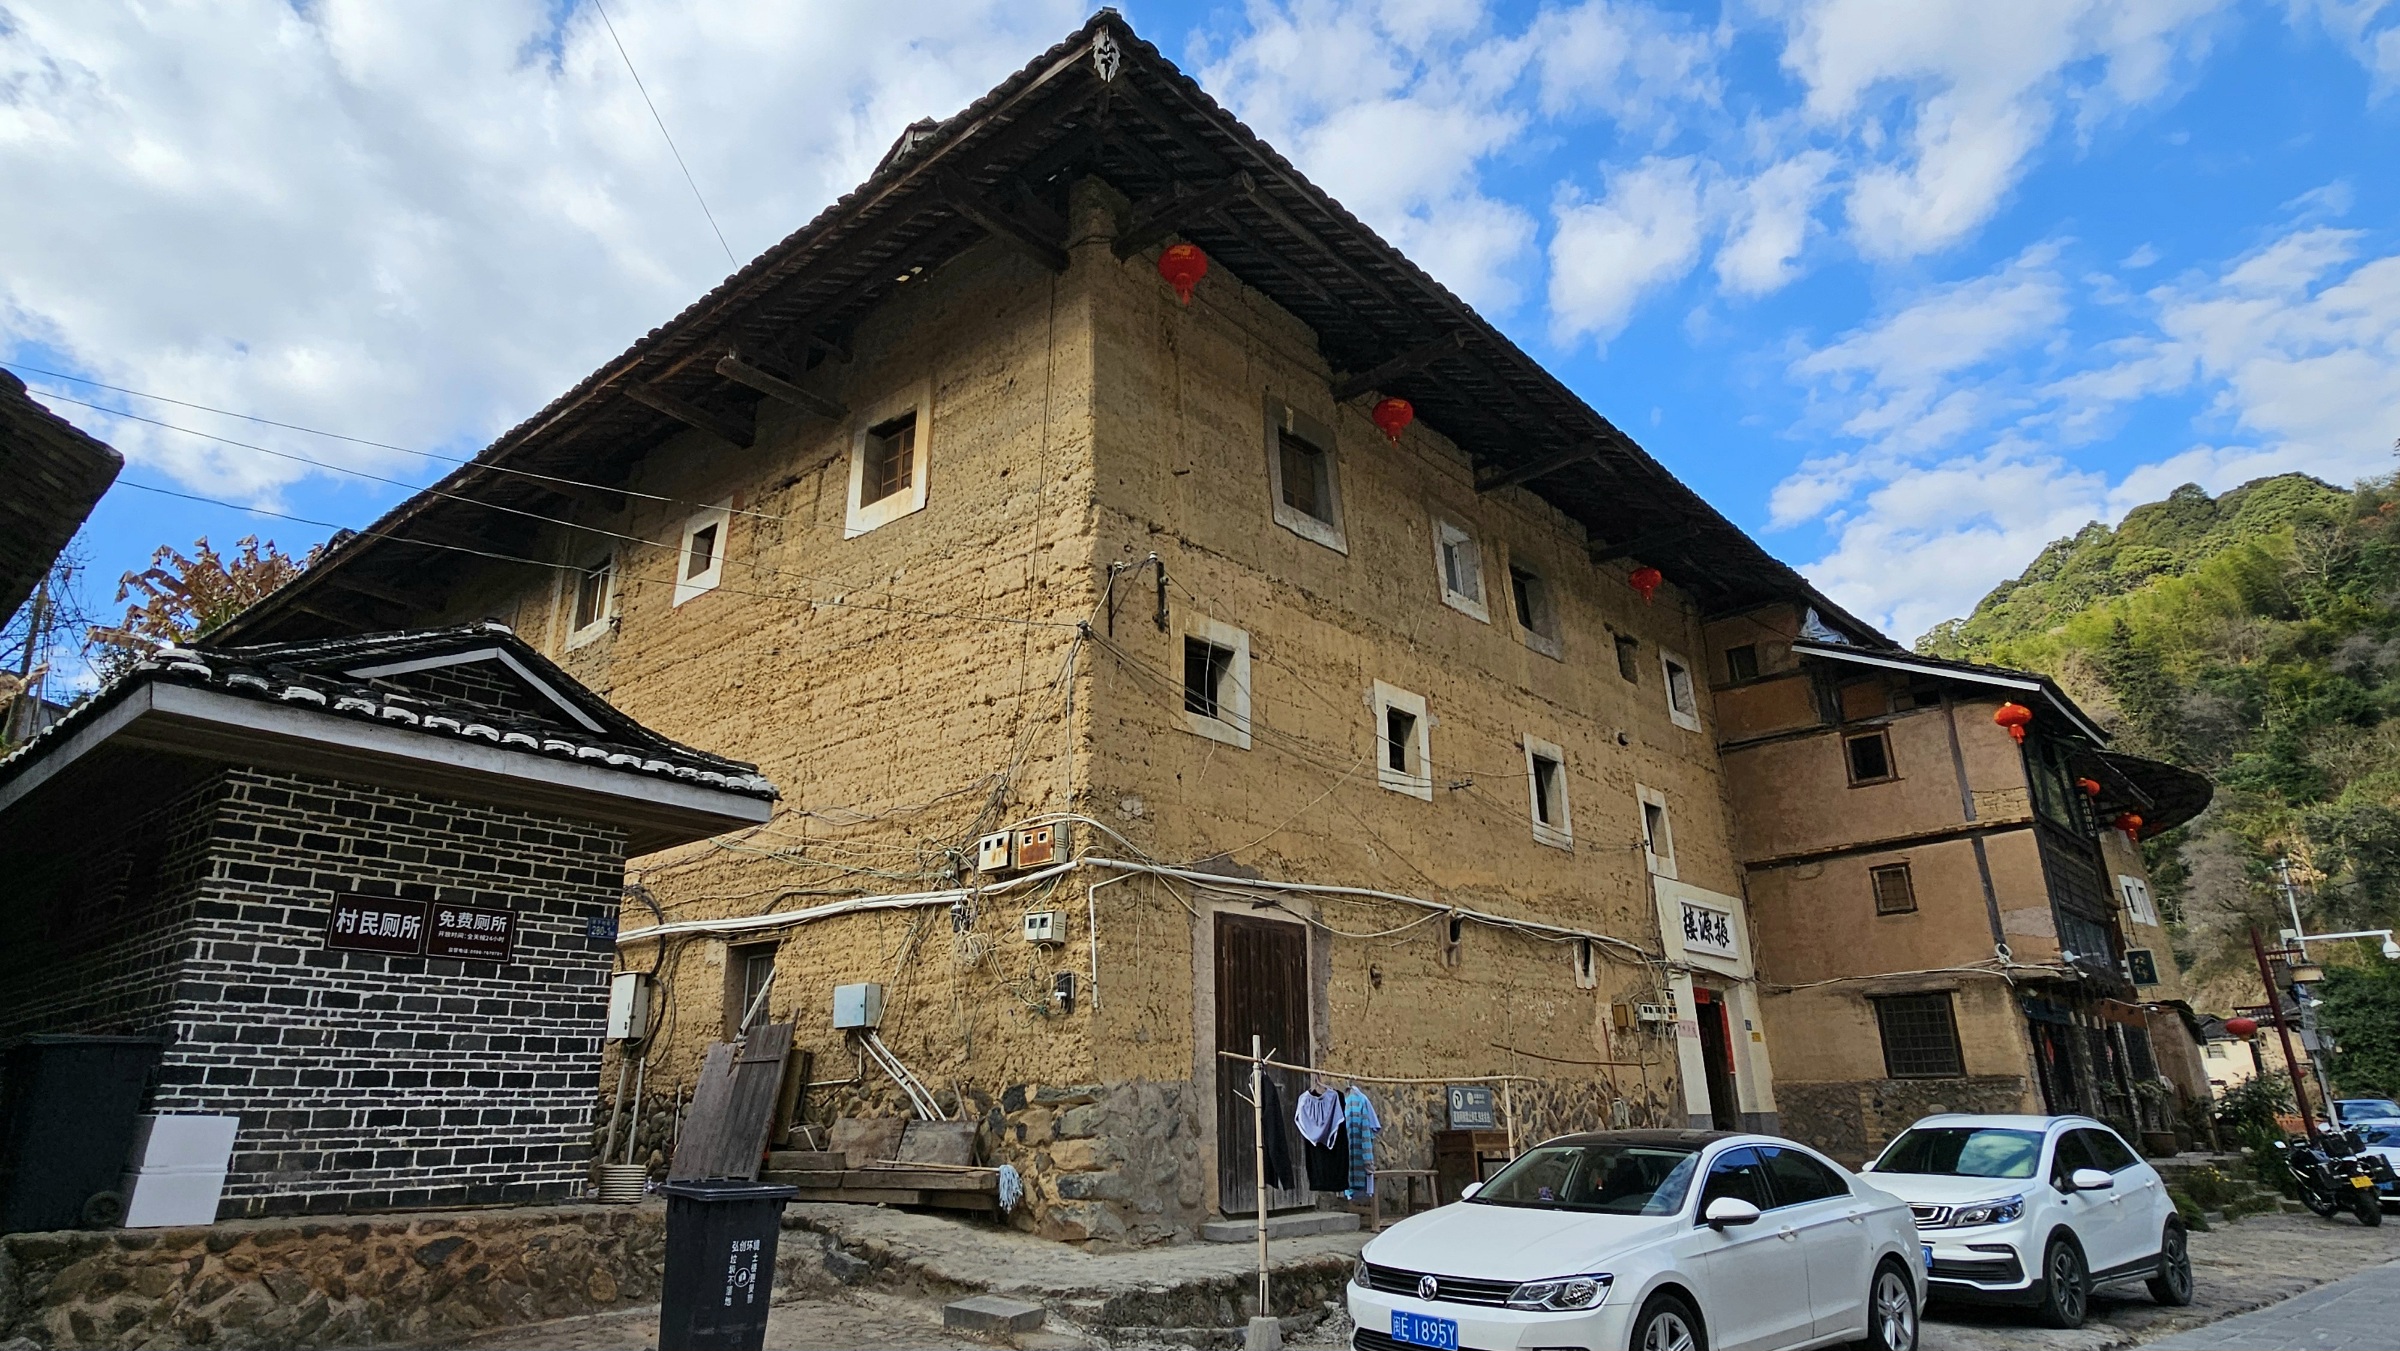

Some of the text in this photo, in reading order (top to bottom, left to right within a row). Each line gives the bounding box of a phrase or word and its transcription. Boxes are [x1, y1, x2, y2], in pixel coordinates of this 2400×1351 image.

[336, 907, 422, 940] 村民厕所
[438, 910, 507, 933] 免费厕所
